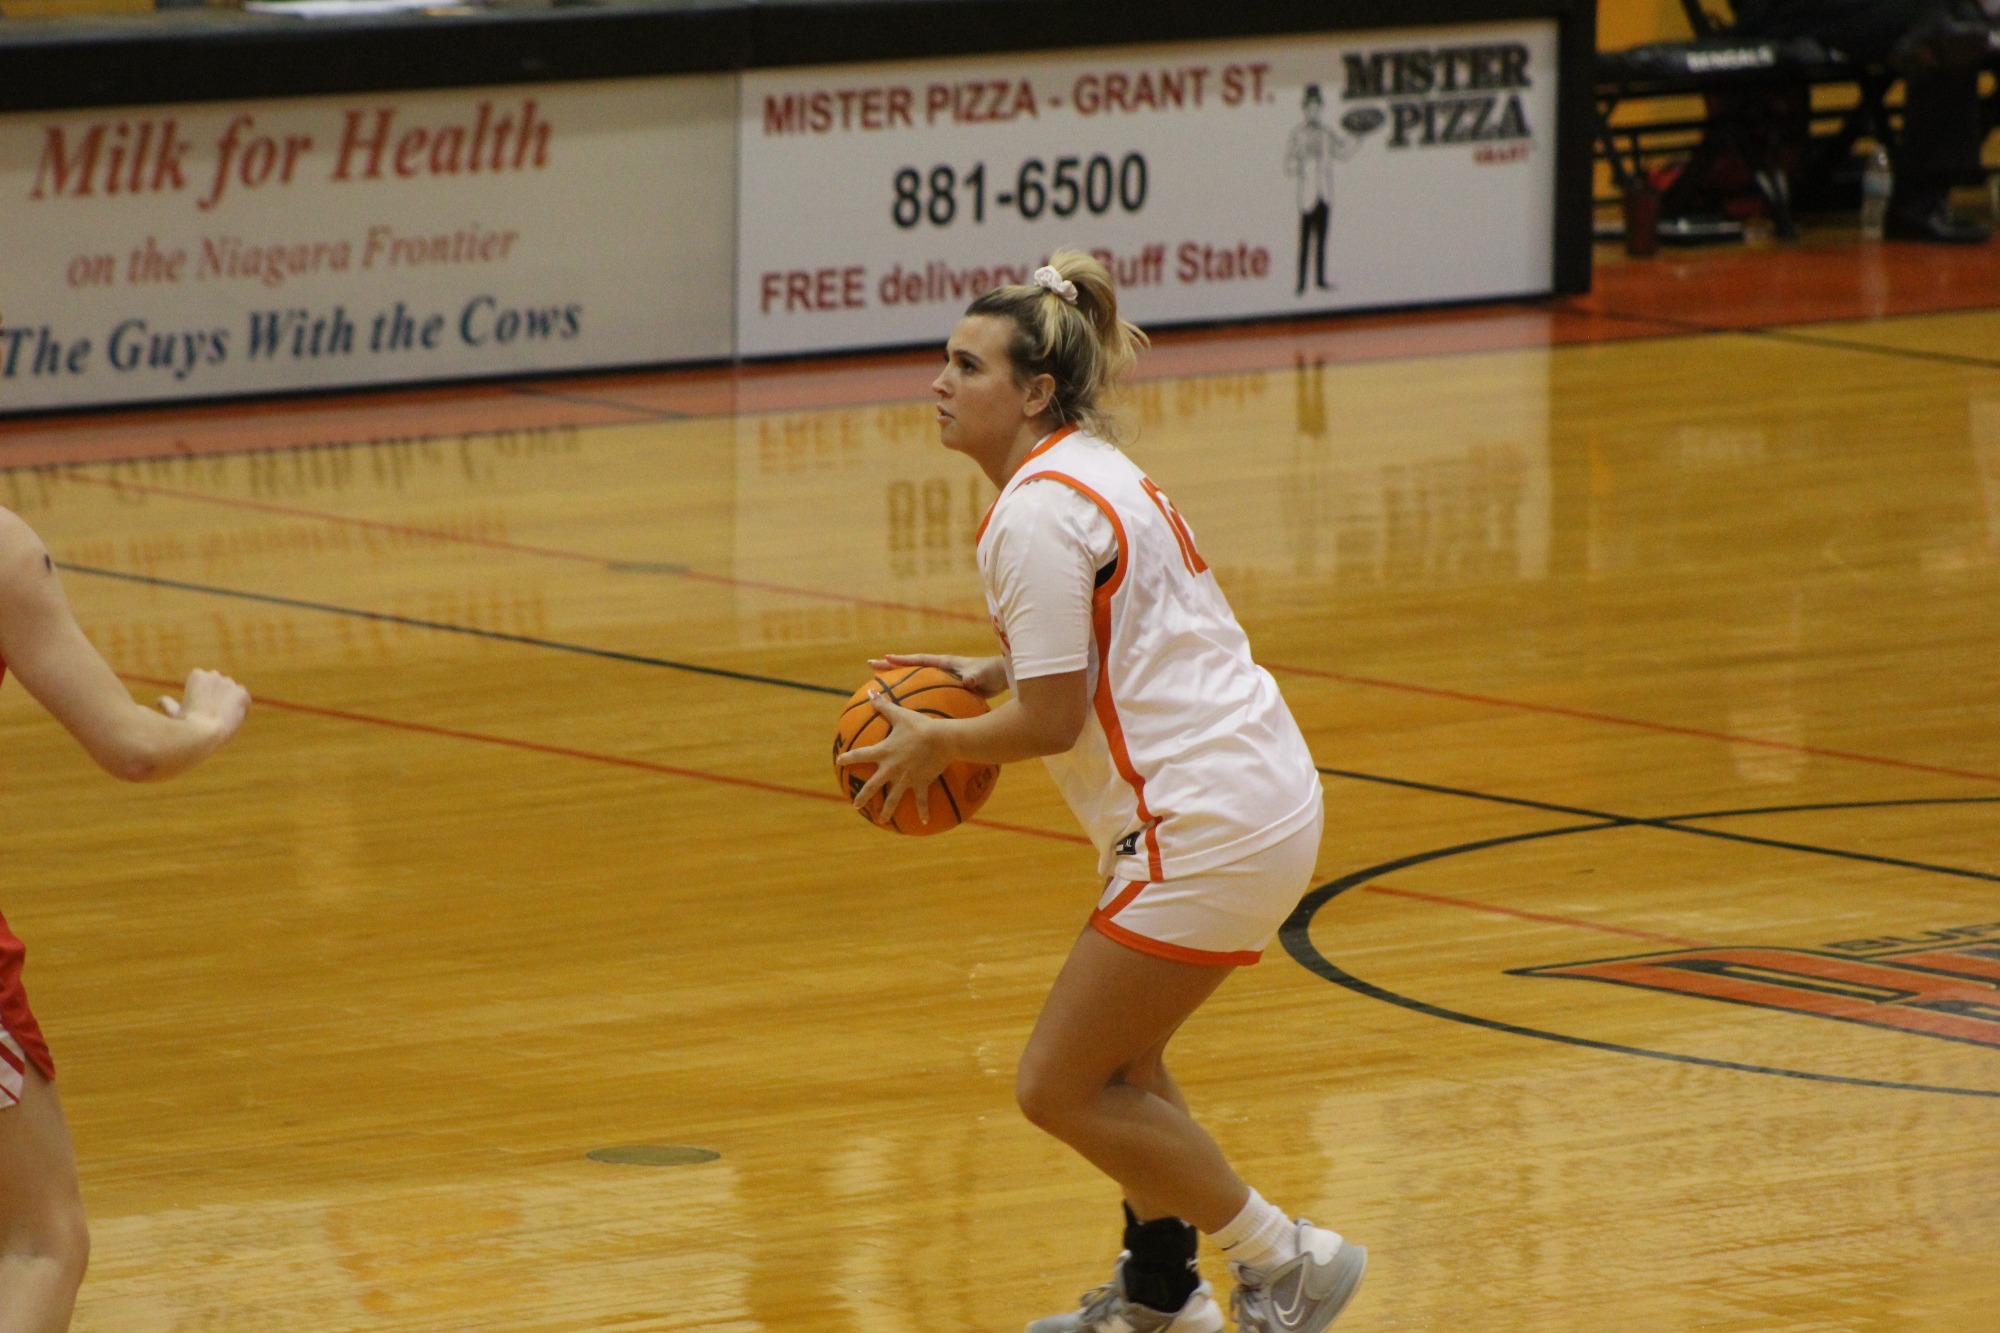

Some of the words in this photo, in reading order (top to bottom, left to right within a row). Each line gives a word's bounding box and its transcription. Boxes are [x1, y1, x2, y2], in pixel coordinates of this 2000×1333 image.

[764, 91, 913, 136] MISTER
[926, 79, 1038, 124] PIZZA
[1072, 69, 1207, 115] GRANT
[1221, 63, 1275, 106] ST.
[1342, 44, 1531, 98] MISTER
[30, 118, 191, 201] Milk
[196, 112, 312, 211] for
[329, 99, 552, 183] Health
[1389, 95, 1531, 146] PIZZA
[892, 151, 1148, 228] 881-6500
[67, 254, 114, 287] on
[127, 235, 186, 283] the
[198, 233, 350, 287] Niagara
[362, 221, 519, 269] Frontier
[760, 266, 865, 314] FREE
[1176, 238, 1271, 285] State
[0, 326, 90, 378] The
[107, 317, 229, 380] Guys
[248, 303, 353, 358] With
[370, 303, 444, 351] the
[458, 295, 583, 345] Cows
